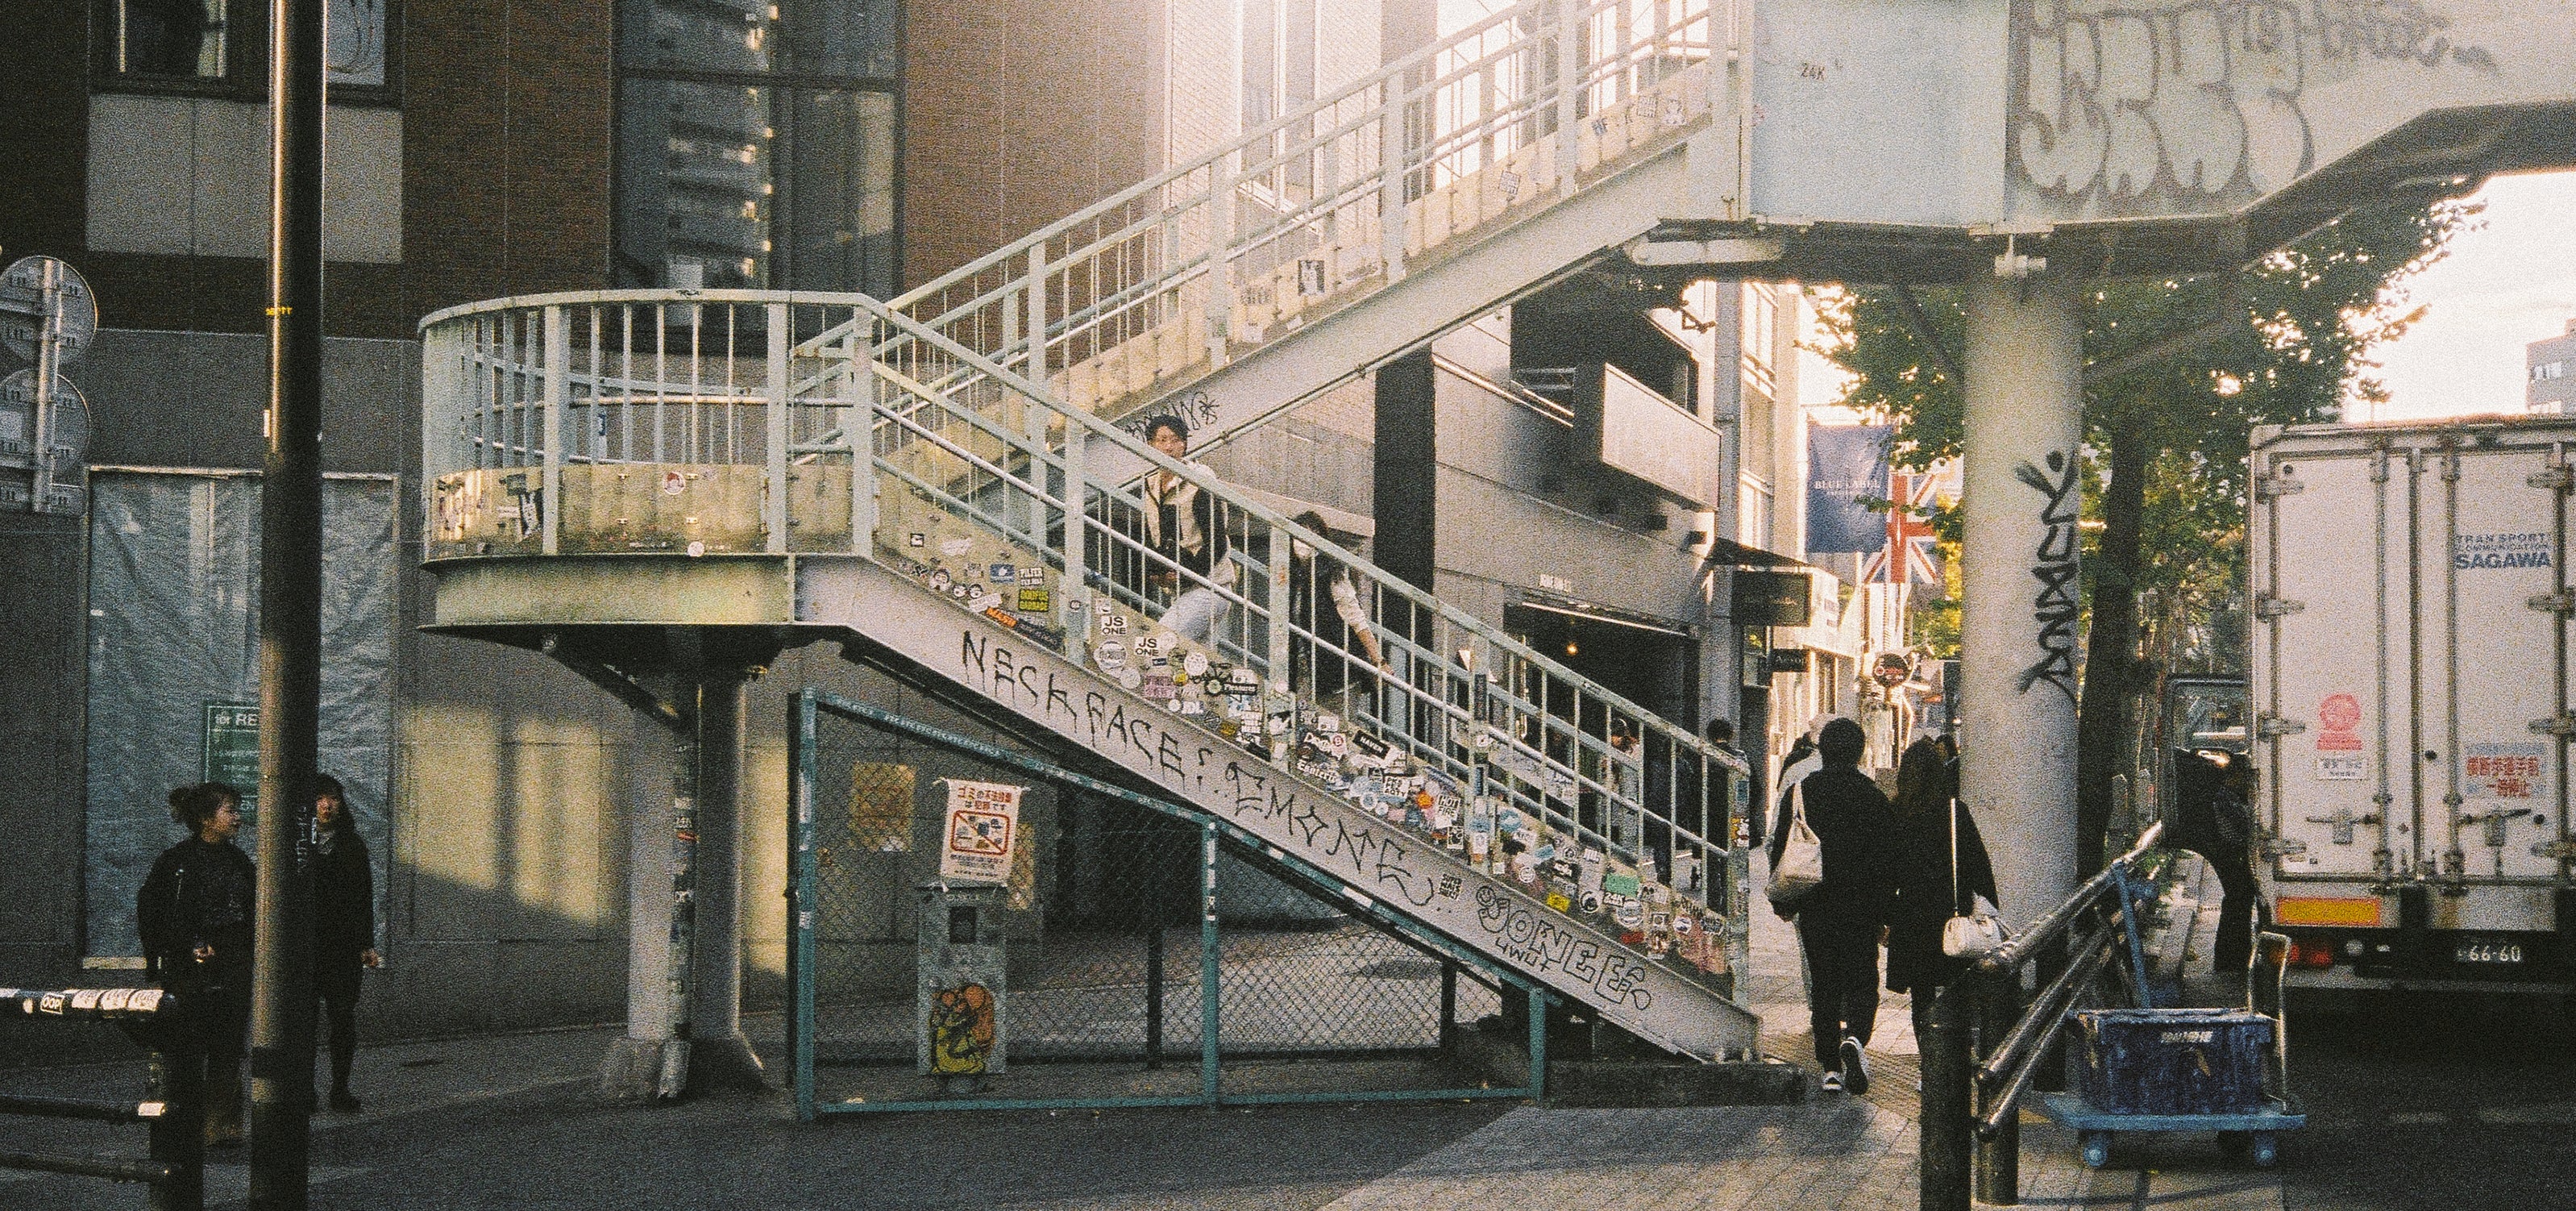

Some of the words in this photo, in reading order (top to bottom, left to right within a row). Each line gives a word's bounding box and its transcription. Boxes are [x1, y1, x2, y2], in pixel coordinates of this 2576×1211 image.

[2456, 552, 2552, 569] SAGAWA
[1104, 616, 1124, 627] JS
[1102, 627, 1126, 635] ONE
[1138, 638, 1157, 648] JS
[1135, 647, 1159, 657] ONE
[235, 714, 259, 726] RE
[2469, 945, 2521, 963] 66-60
